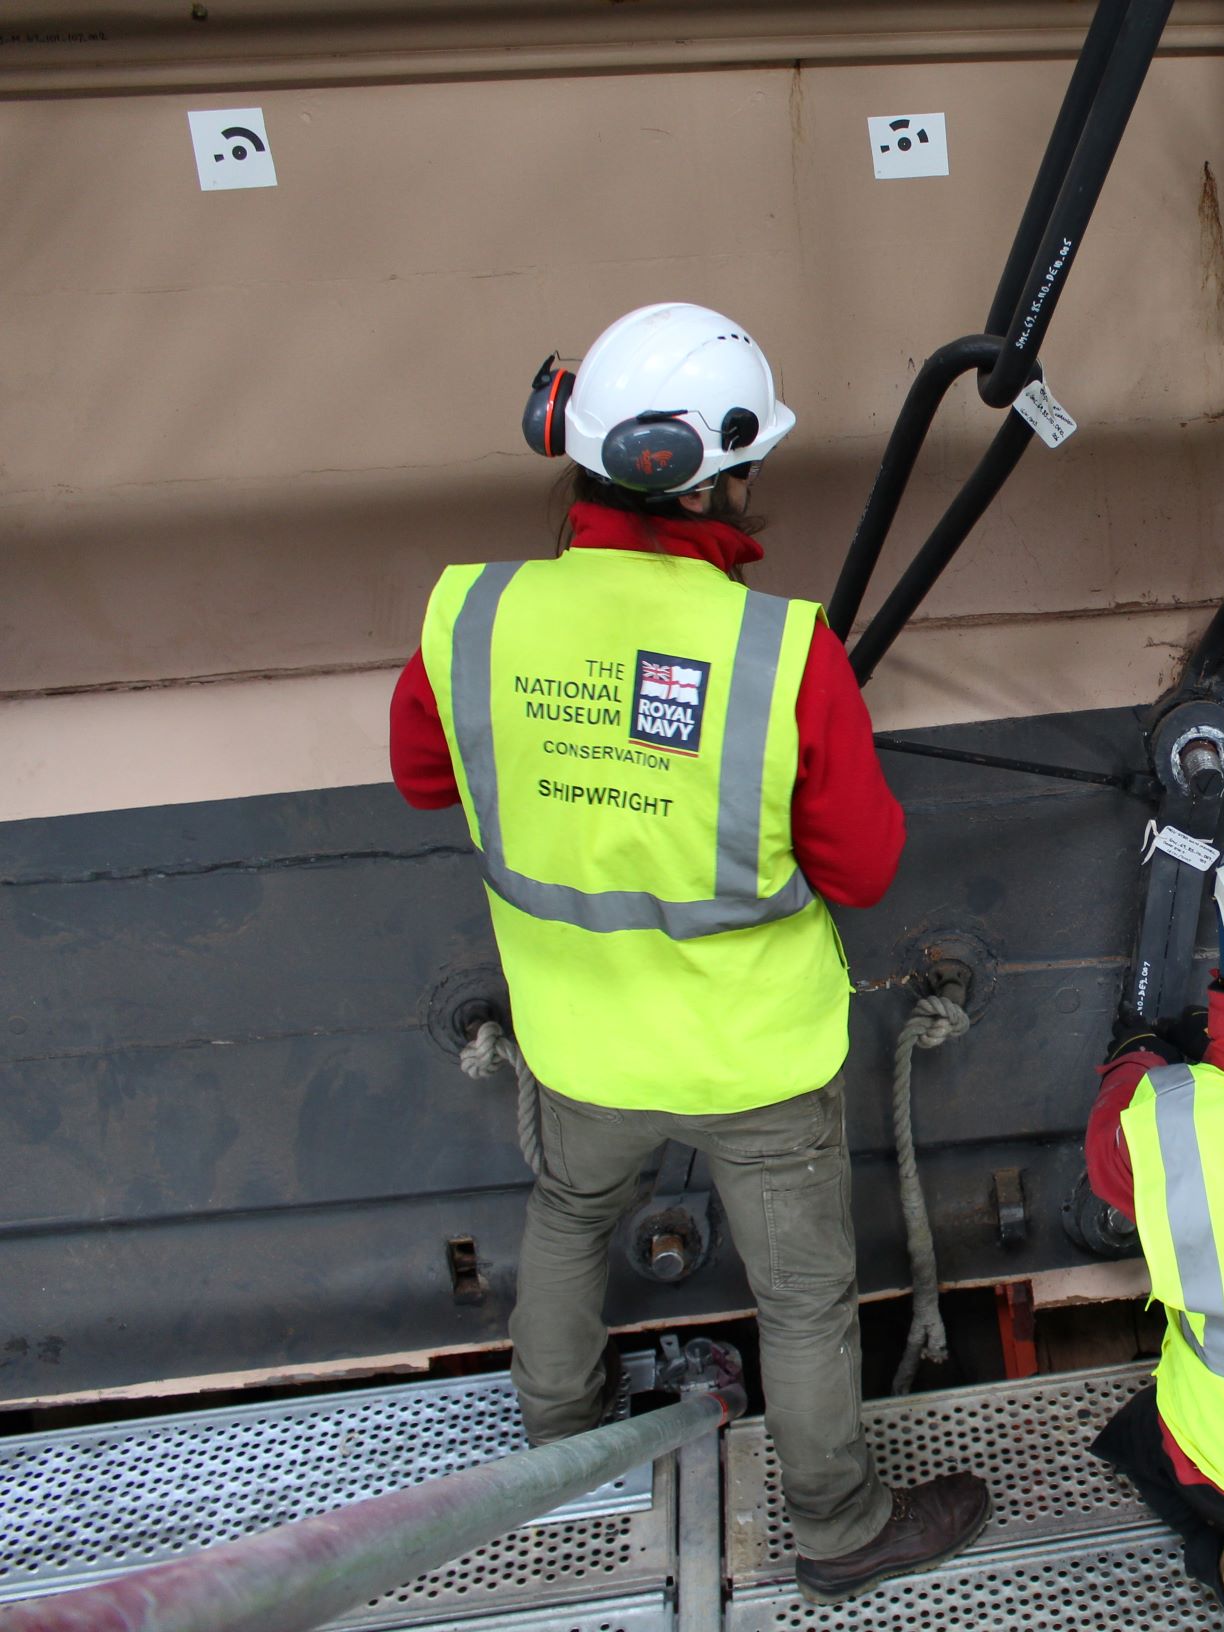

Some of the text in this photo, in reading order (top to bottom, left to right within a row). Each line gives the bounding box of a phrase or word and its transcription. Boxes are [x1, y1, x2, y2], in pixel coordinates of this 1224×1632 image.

[586, 659, 625, 681] THE
[514, 675, 623, 703] NATIONAL
[526, 701, 621, 726] MUSEUM
[638, 698, 695, 724] ROYAL
[637, 716, 694, 741] NAVY
[543, 740, 670, 771] CONSERVATION
[538, 779, 674, 817] SHIPWRIGHT
